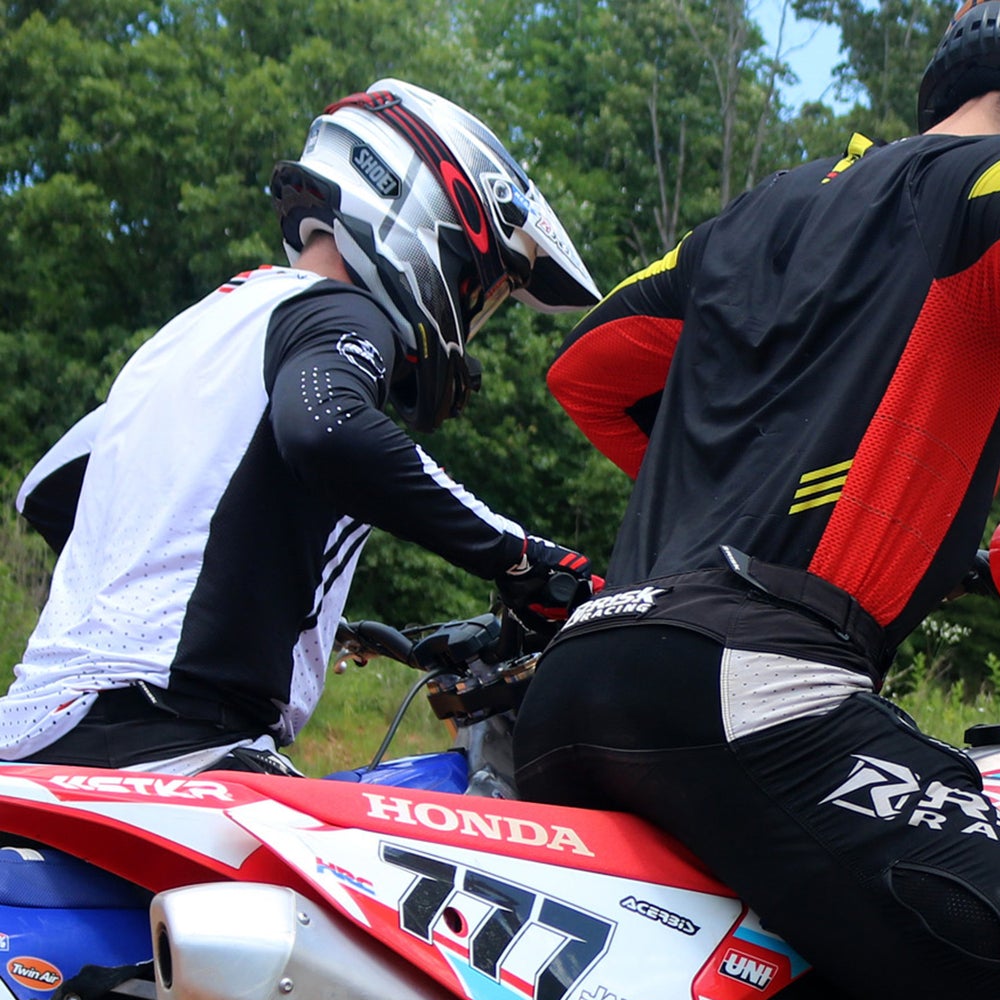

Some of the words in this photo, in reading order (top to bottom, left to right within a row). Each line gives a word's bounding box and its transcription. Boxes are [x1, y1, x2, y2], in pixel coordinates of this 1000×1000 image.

[354, 148, 397, 195] SHOEI
[579, 602, 652, 622] RACING
[362, 792, 596, 858] HONDA
[315, 856, 376, 896] HRC
[12, 962, 41, 981] Twin
[39, 971, 60, 985] Air
[724, 952, 774, 988] UNI
